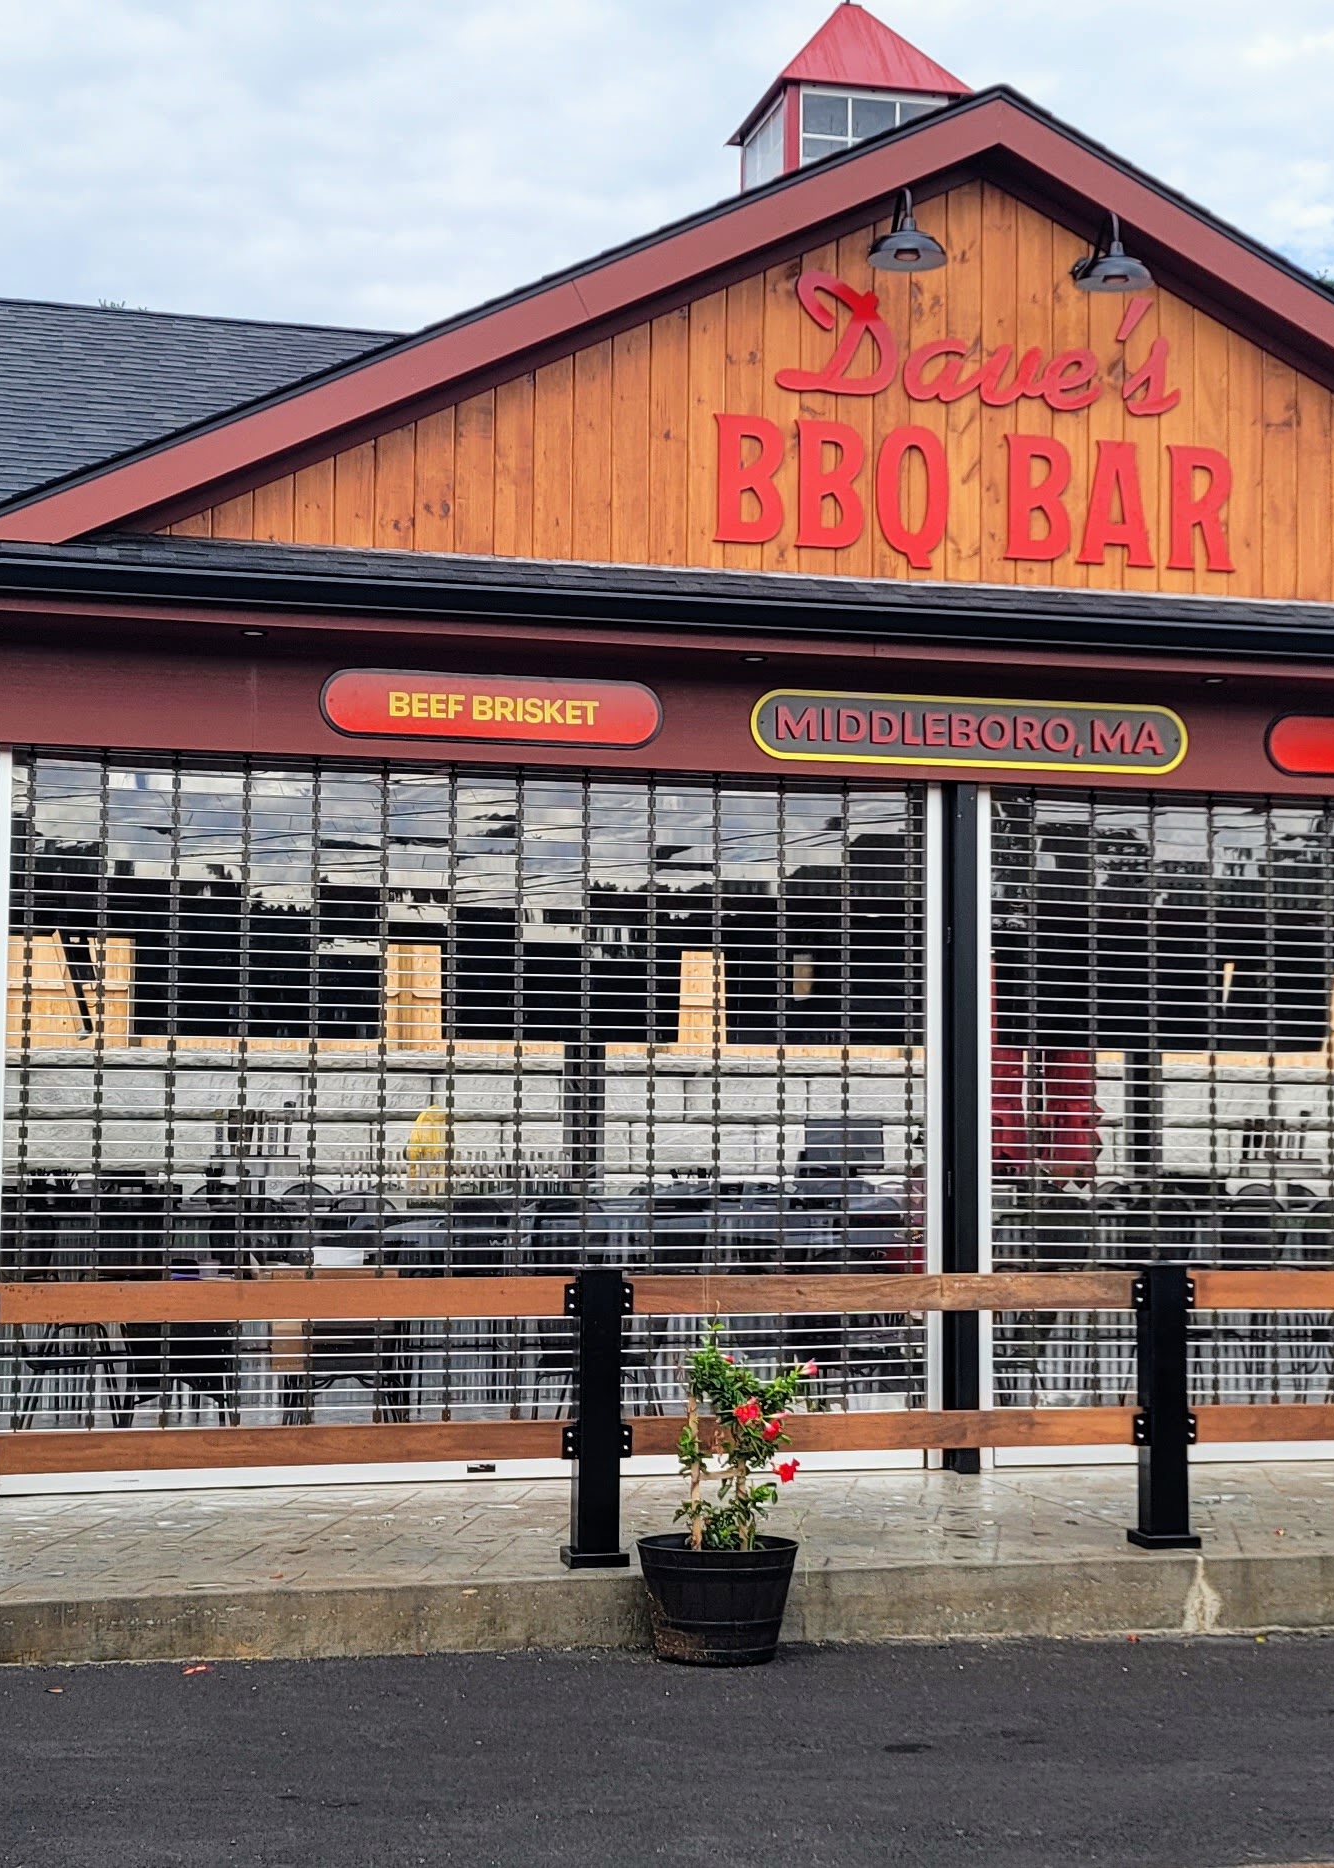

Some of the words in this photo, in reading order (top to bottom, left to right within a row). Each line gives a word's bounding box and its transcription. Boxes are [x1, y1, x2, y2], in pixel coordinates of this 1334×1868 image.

[775, 271, 1181, 416] Dave's
[713, 413, 950, 569] BBQ
[1003, 433, 1235, 572] BAR
[388, 691, 466, 719] BEEF
[471, 695, 600, 726] BRISKET
[775, 705, 1085, 757] MIDDLEBORO,
[1090, 718, 1164, 755] MA
